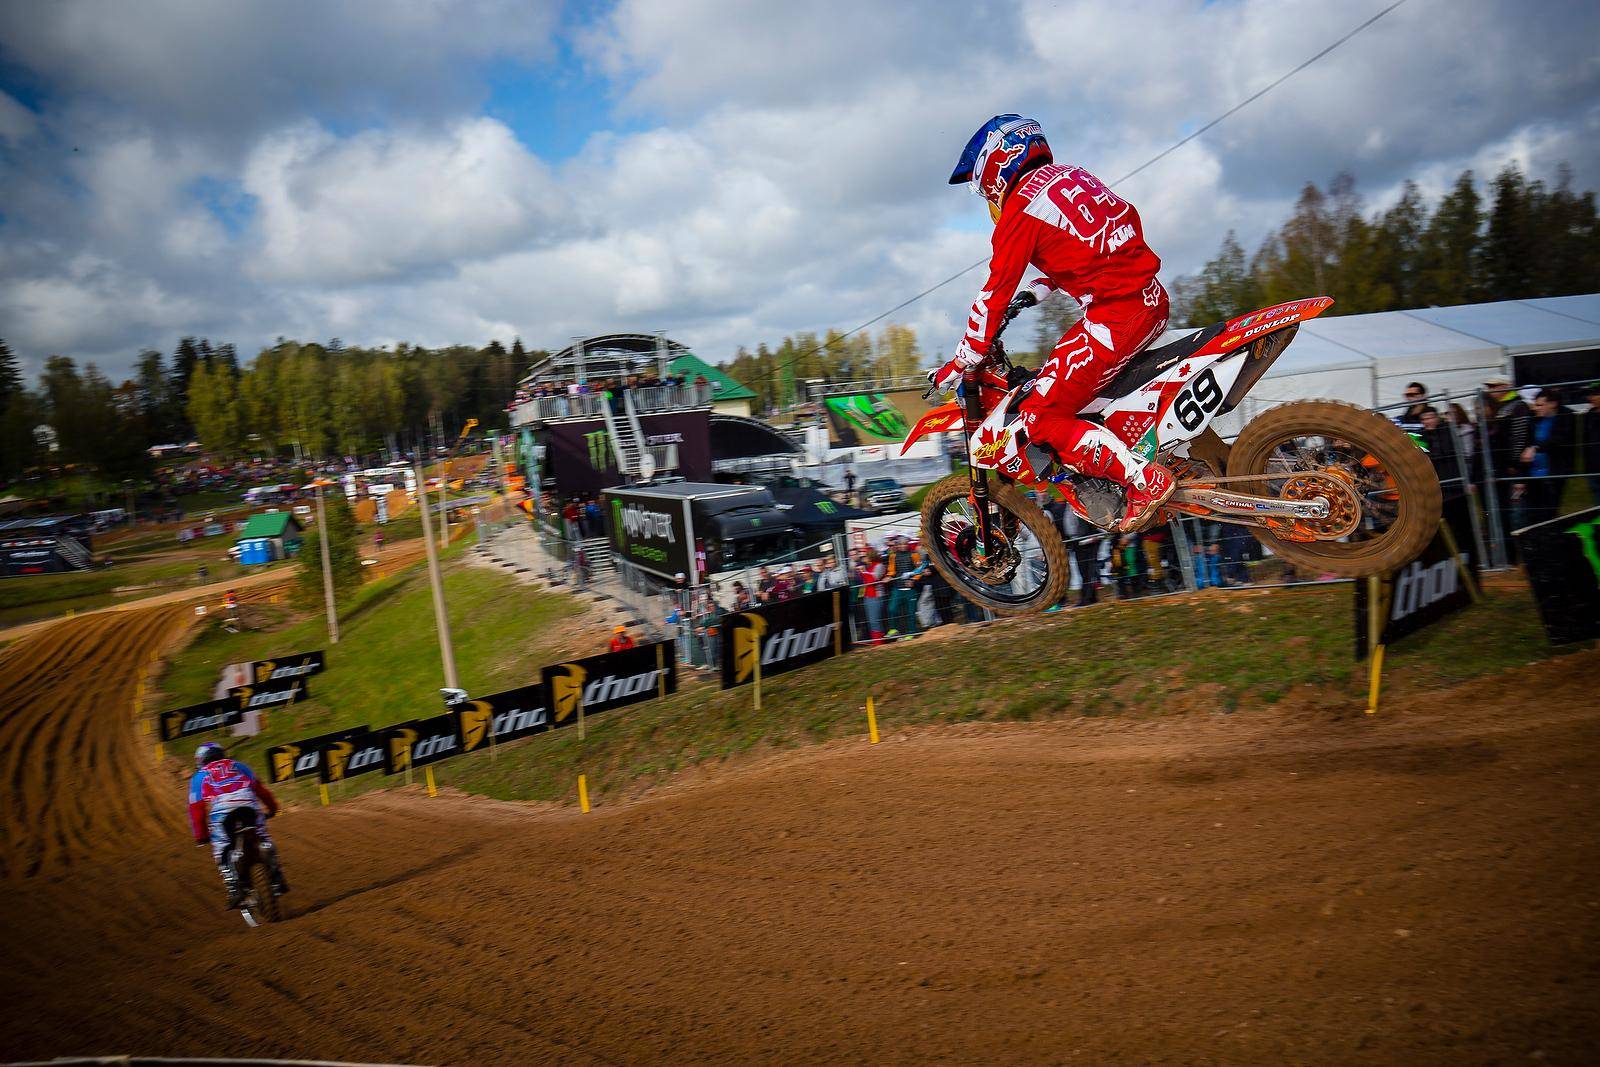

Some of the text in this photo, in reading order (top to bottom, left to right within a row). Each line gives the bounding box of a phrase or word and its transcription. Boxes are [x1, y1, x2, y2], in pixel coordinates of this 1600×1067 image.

[1107, 224, 1137, 253] KTM
[1243, 313, 1301, 338] DUNLOP
[1174, 368, 1224, 432] 69
[1391, 553, 1469, 620] thor
[761, 621, 843, 666] thor
[583, 668, 670, 706] thor
